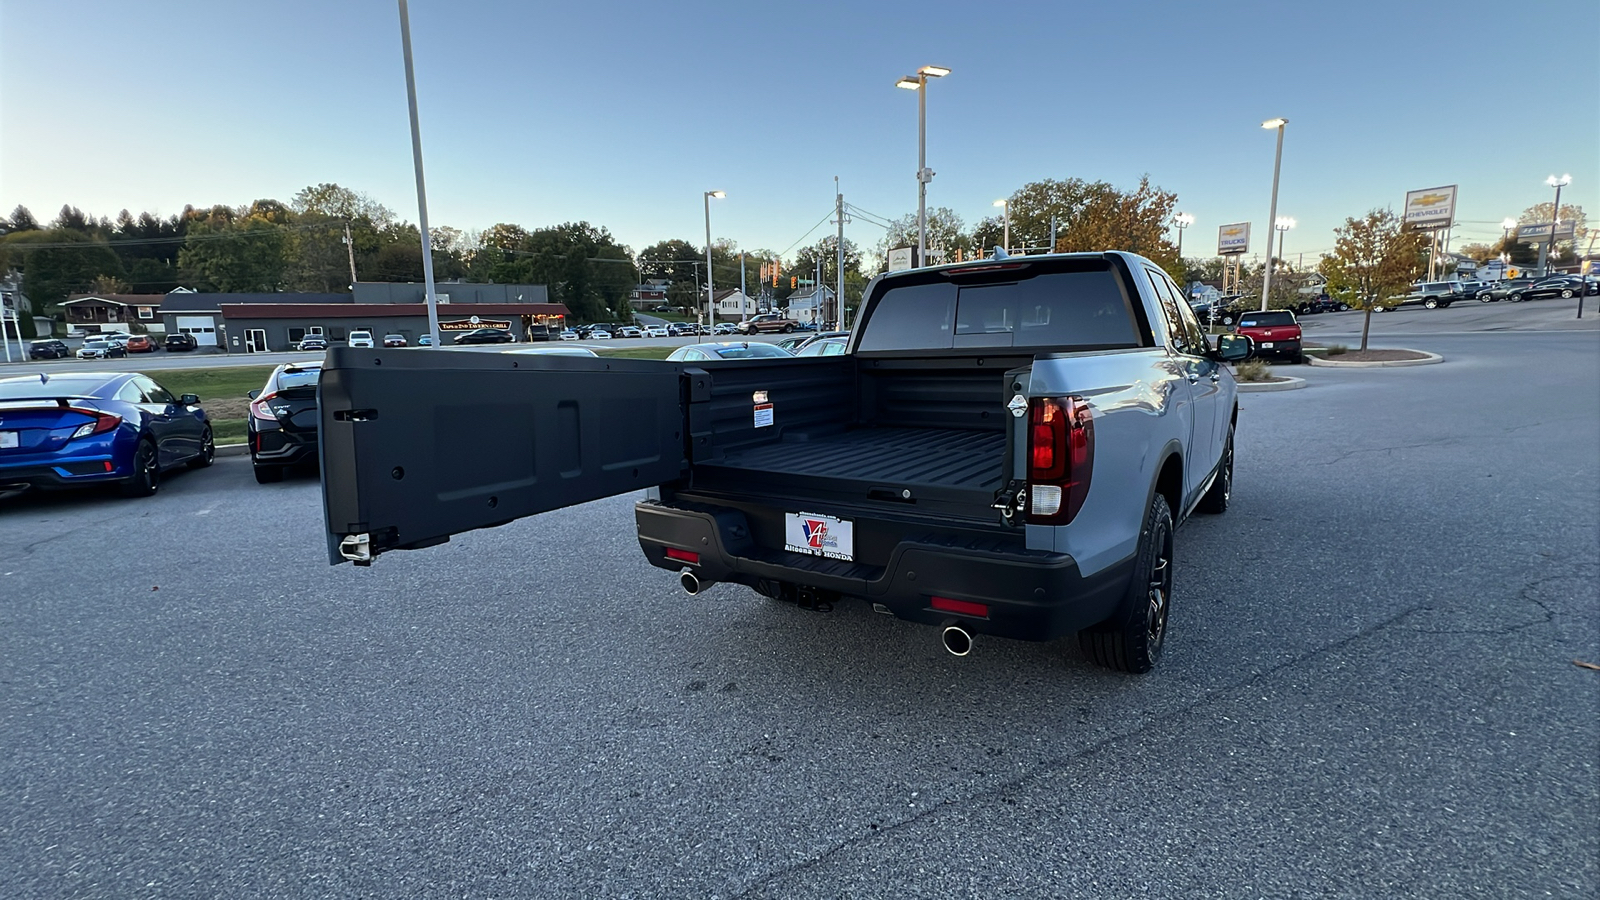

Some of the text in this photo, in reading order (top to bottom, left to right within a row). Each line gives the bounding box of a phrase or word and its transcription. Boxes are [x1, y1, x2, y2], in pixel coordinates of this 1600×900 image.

[1408, 208, 1448, 218] CHEVROLET
[1221, 238, 1245, 246] TRUCKS
[784, 544, 813, 555] Altoona
[823, 551, 854, 562] HONDA
